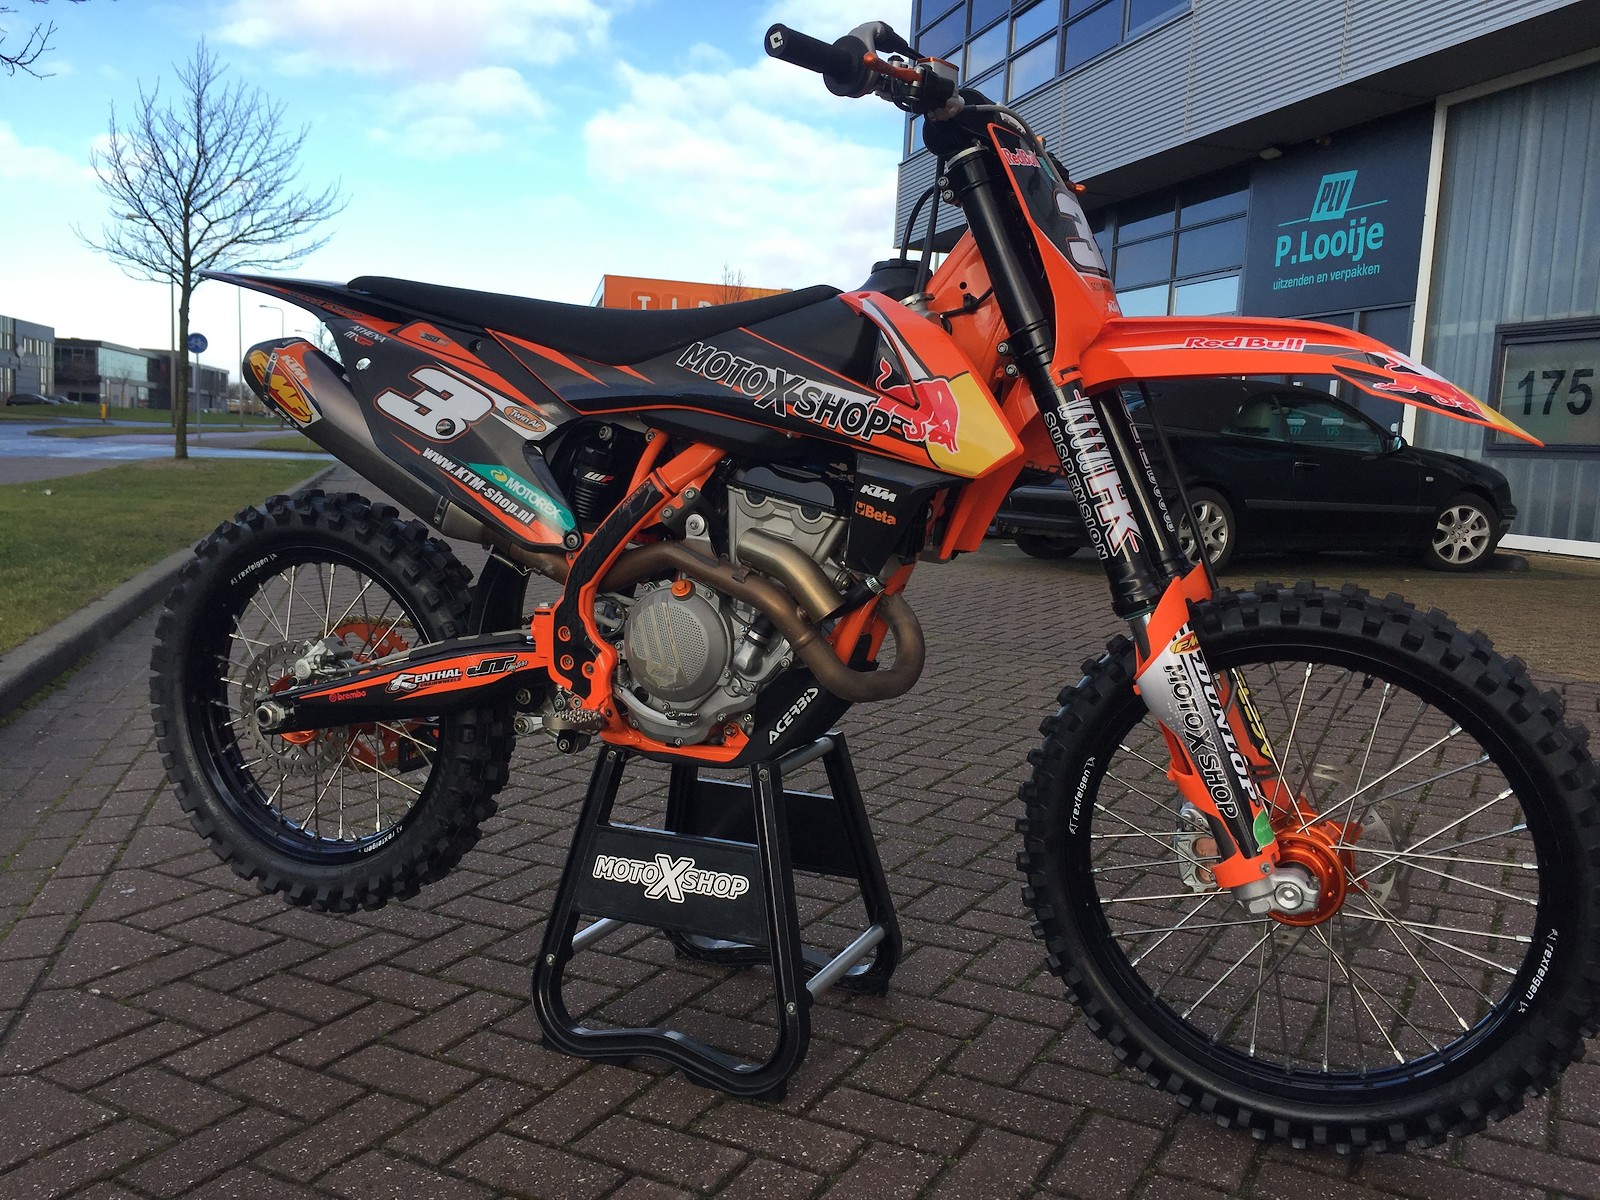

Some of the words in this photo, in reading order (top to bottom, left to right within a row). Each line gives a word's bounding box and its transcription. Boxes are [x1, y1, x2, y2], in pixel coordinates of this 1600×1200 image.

[1315, 178, 1351, 214] PLV
[1275, 216, 1385, 268] P.Looije
[1272, 274, 1314, 290] uitzenden
[1316, 272, 1328, 283] en
[1330, 263, 1380, 281] verpakken
[350, 325, 387, 343] ATHENA
[280, 354, 309, 381] KTM
[375, 364, 495, 443] 3
[1517, 368, 1594, 416] 175
[510, 408, 530, 424] Twin
[528, 418, 543, 429] Air
[422, 447, 536, 525] www.KTM-shop.nl
[583, 471, 615, 483] WP
[860, 483, 897, 503] KTM
[1043, 411, 1109, 561] SUSPENSION
[504, 476, 563, 521] MOTOREX
[865, 504, 897, 525] Beta
[337, 690, 367, 701] brembo
[768, 687, 819, 745] ACERBIS
[1193, 655, 1260, 808] DUNLOP
